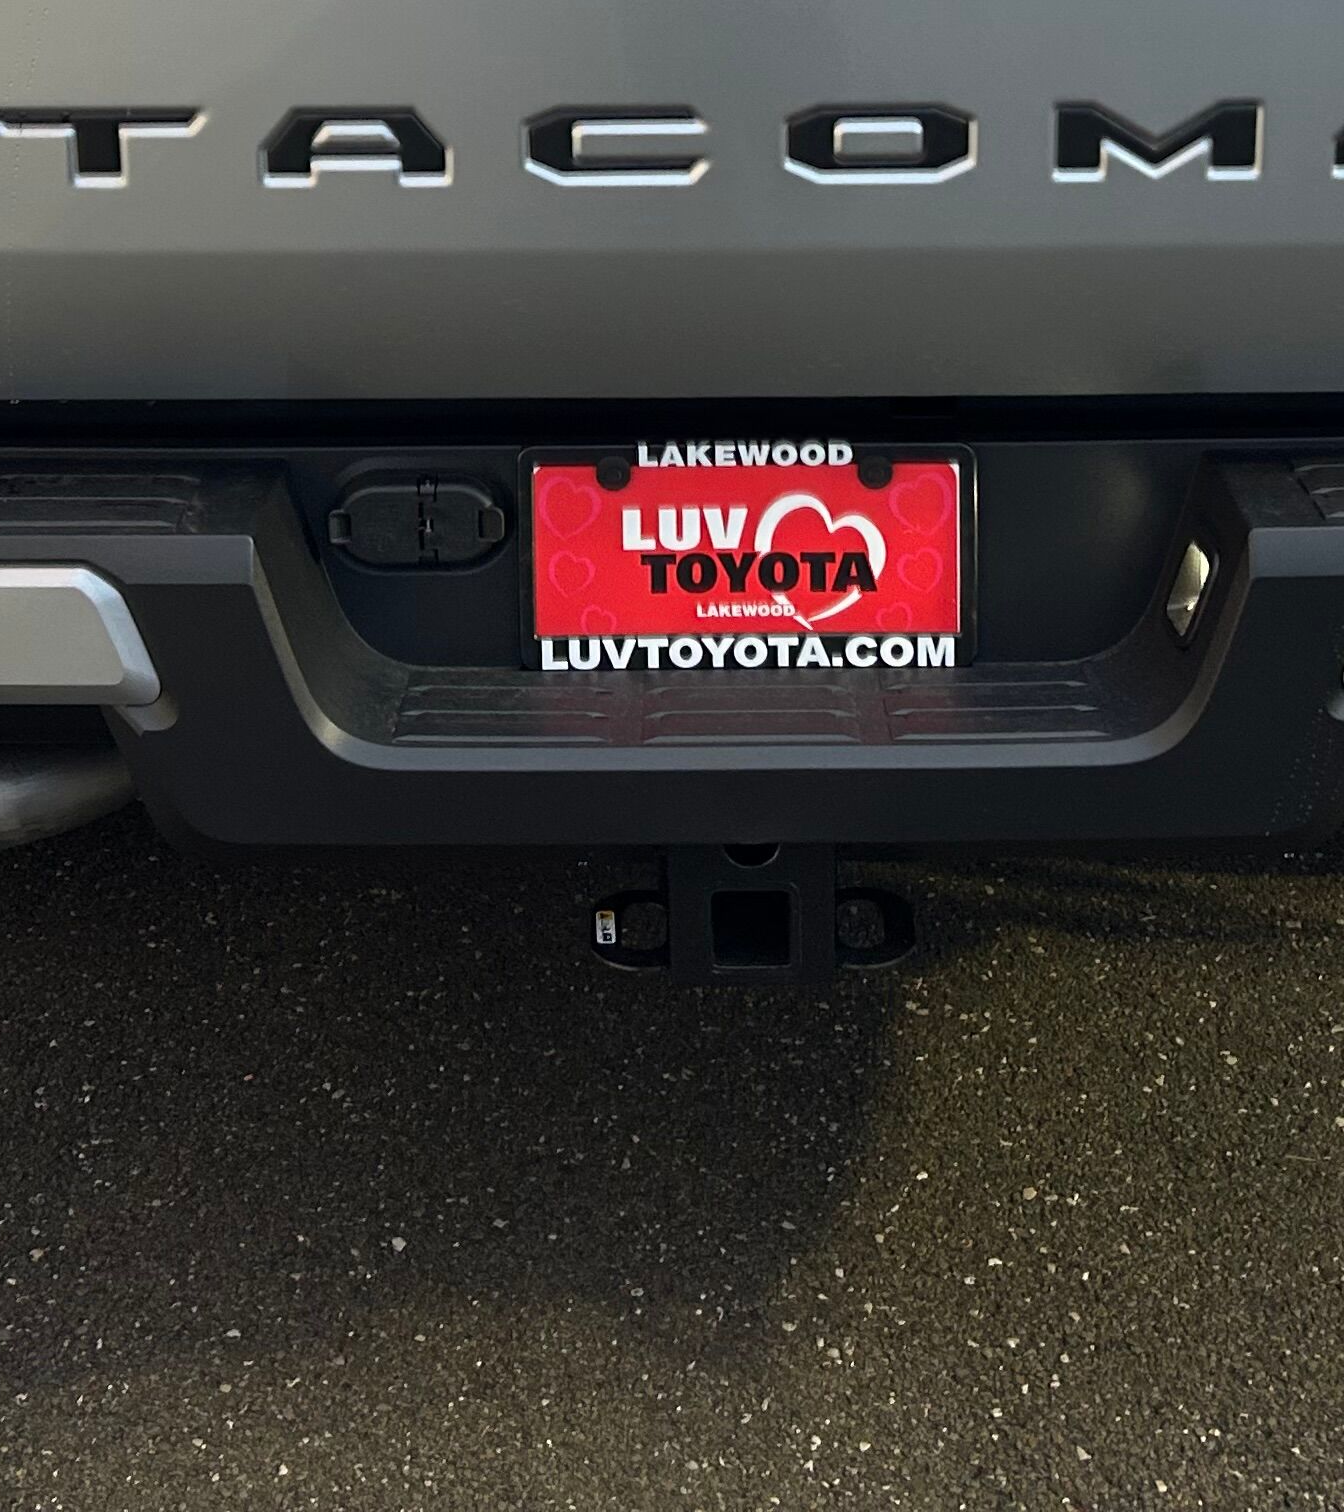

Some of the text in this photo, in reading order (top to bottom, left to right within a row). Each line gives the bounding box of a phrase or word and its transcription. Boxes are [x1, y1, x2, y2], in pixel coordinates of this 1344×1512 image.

[637, 441, 854, 467] LAKEWOOD
[622, 505, 749, 552] LUV
[640, 551, 878, 594] TOYOTA
[696, 602, 796, 618] LAKEWOOD
[540, 635, 956, 671] LUVTOYOTA.COM
